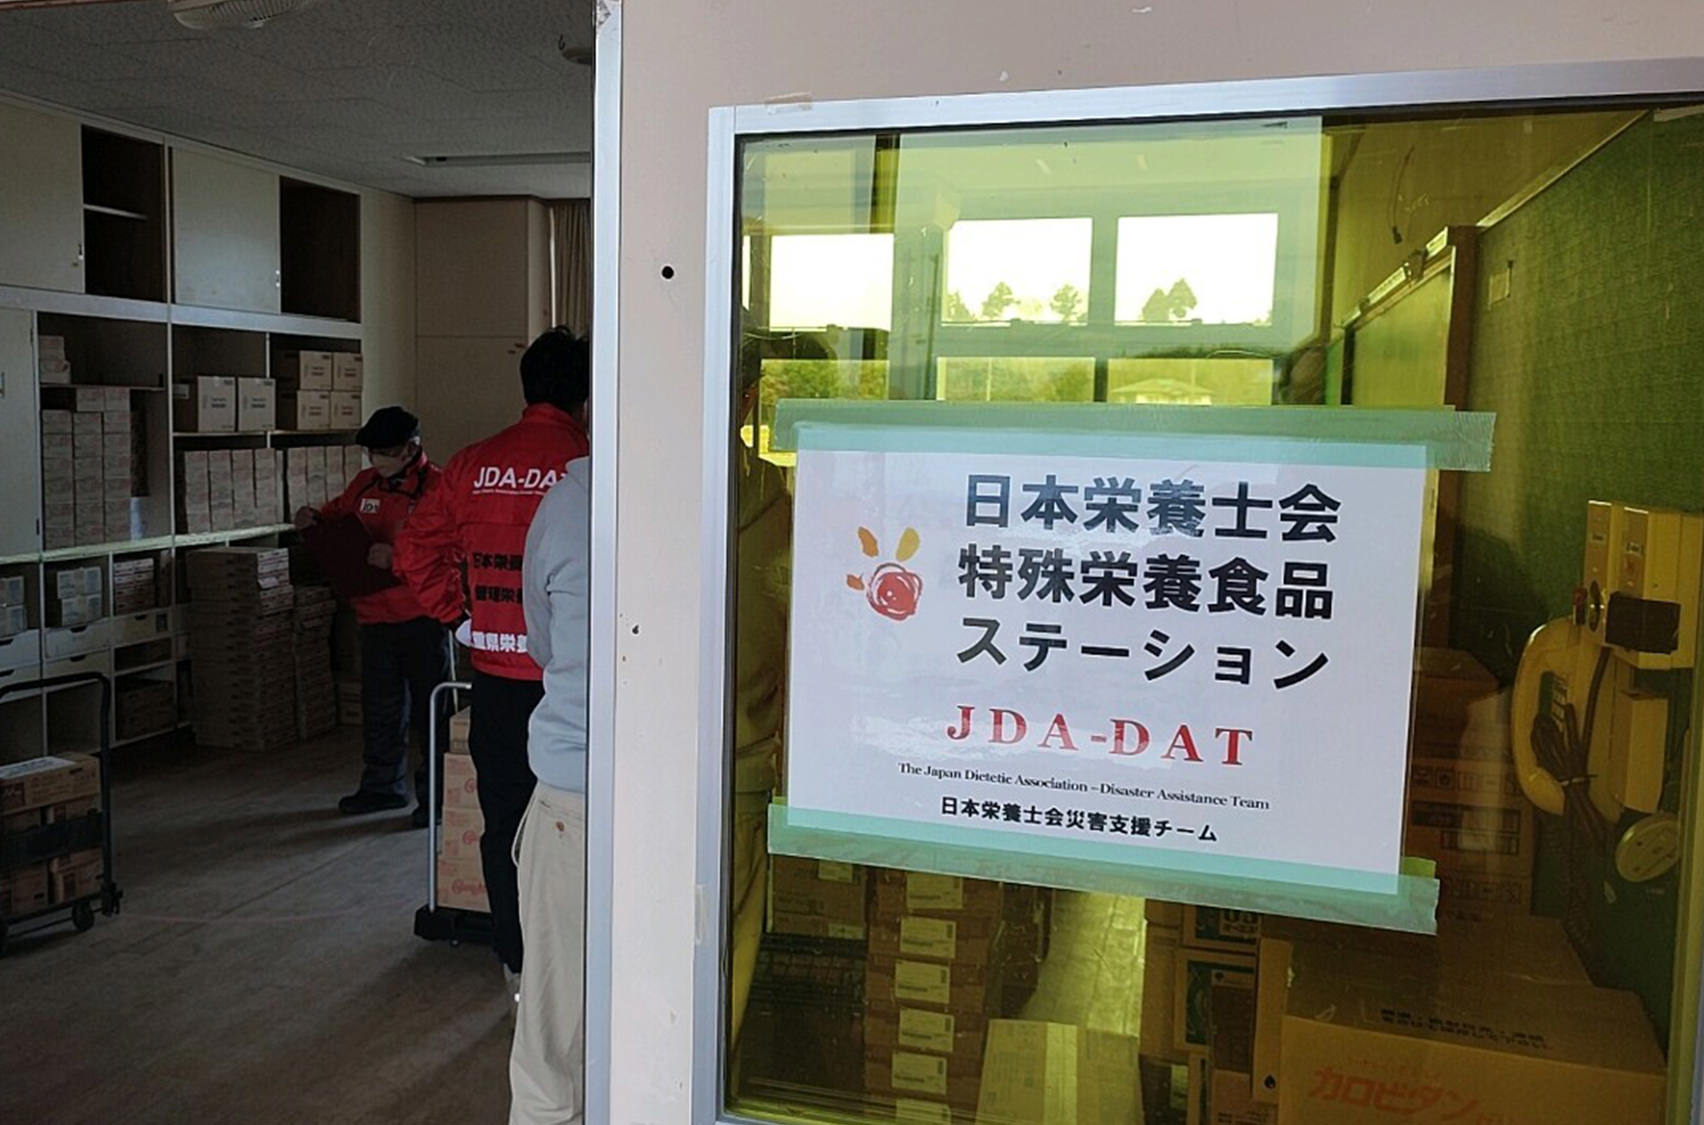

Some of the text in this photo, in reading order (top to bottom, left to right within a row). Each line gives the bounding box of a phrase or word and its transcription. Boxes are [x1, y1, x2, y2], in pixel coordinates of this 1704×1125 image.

[965, 474, 1342, 543] 日本栄養士会
[957, 544, 1335, 620] 特殊栄養食品
[956, 616, 1330, 690] ステーション
[946, 704, 1254, 766] JDA-DAT
[898, 762, 922, 776] The
[924, 765, 961, 780] Japan
[965, 769, 1012, 785] Dietetic
[1015, 775, 1088, 793] Association
[1156, 789, 1228, 806] Assistance
[1230, 795, 1270, 810] Team
[941, 796, 1218, 843] 日本栄養士会災害支援チーム
